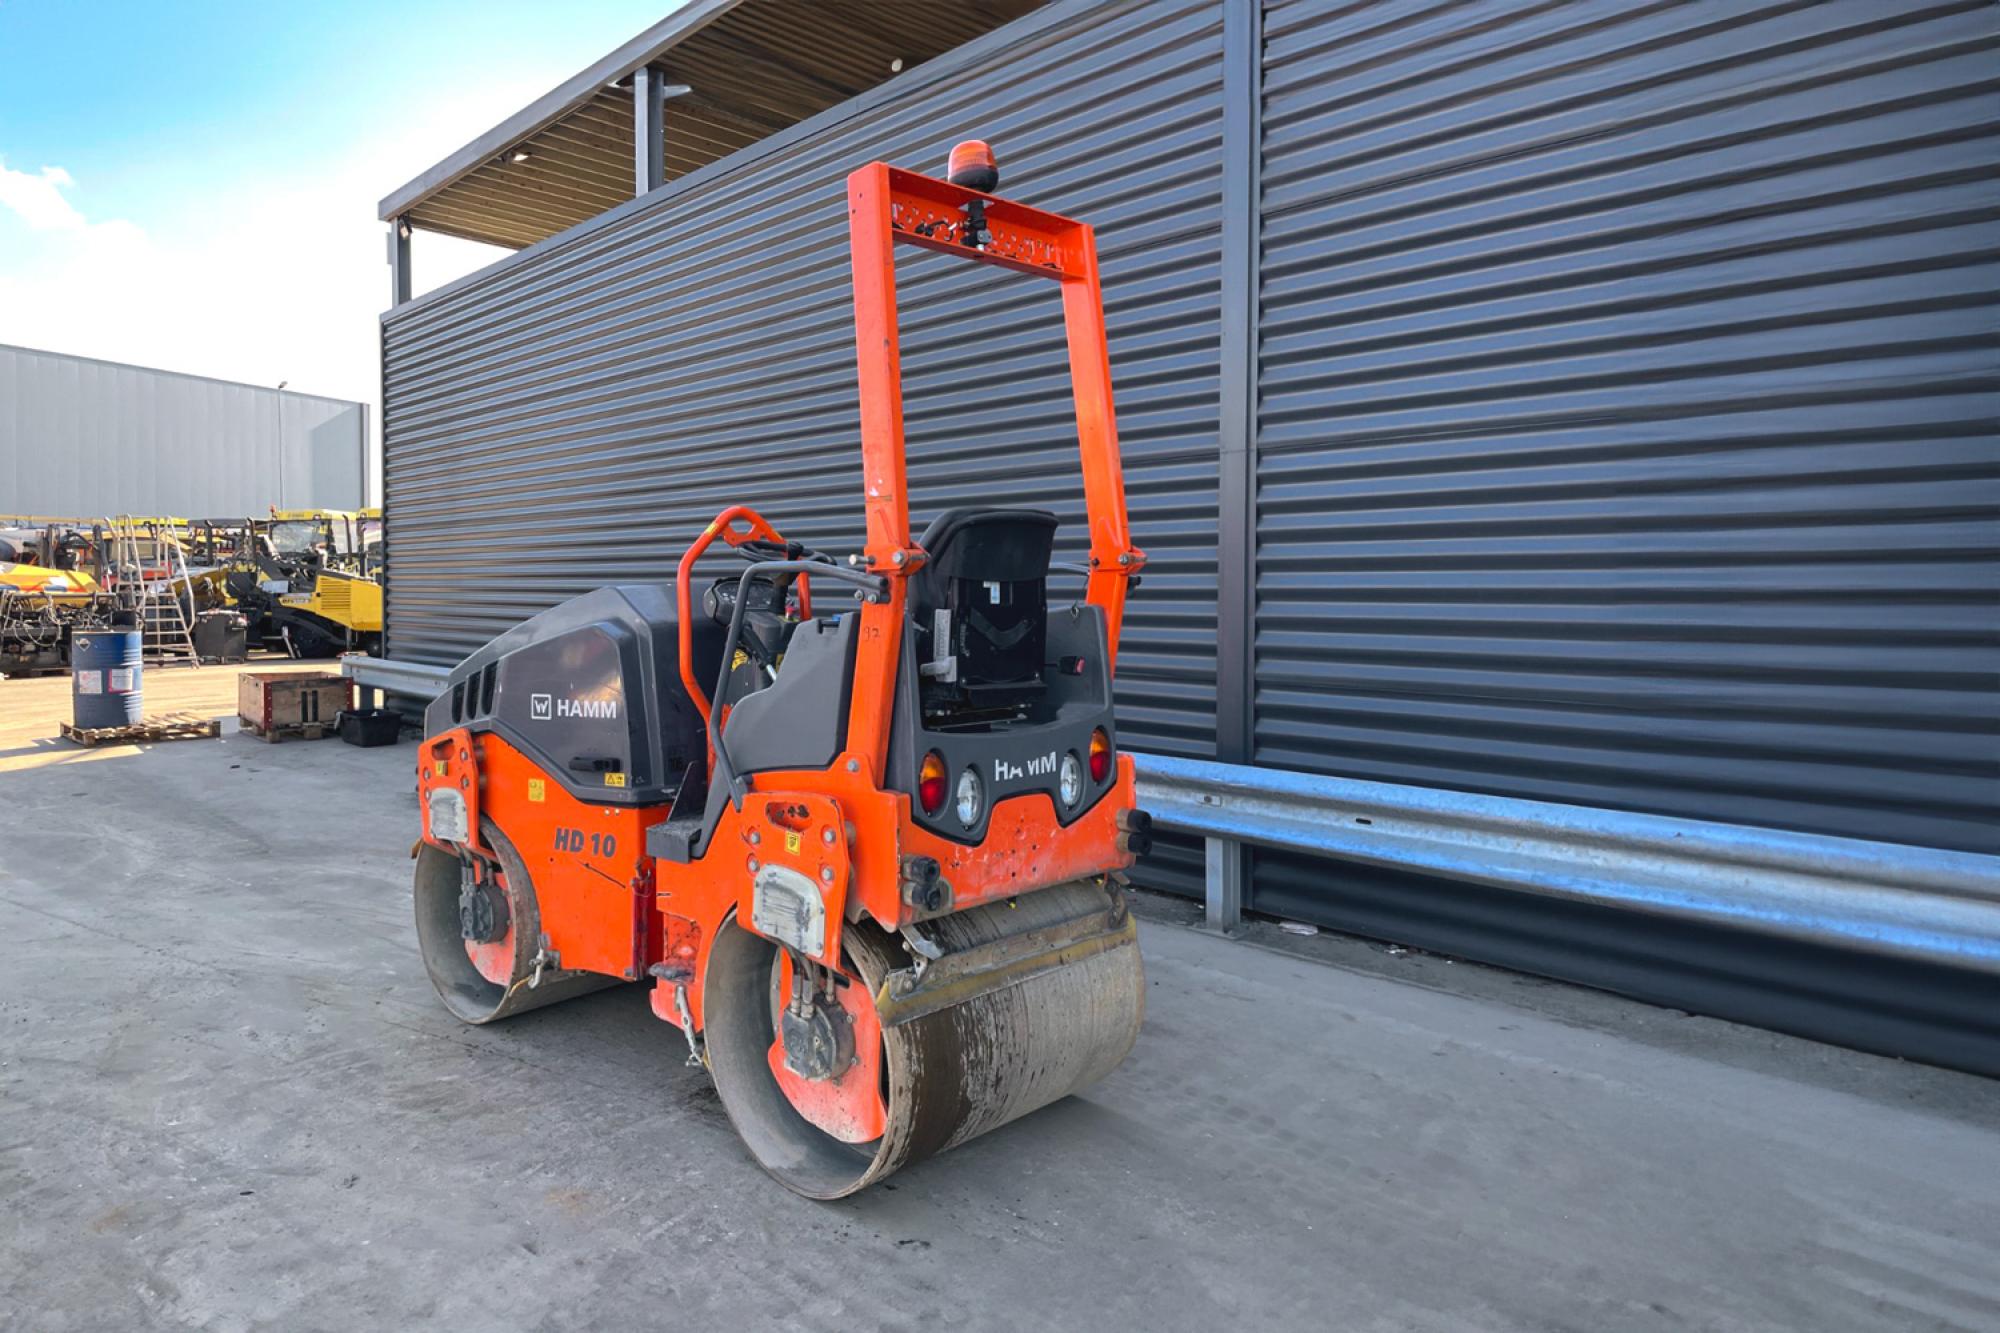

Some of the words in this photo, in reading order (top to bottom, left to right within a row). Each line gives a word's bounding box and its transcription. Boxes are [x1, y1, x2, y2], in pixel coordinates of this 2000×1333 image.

[557, 699, 617, 719] HAMM
[554, 827, 585, 853] HD
[591, 832, 617, 858] 10
